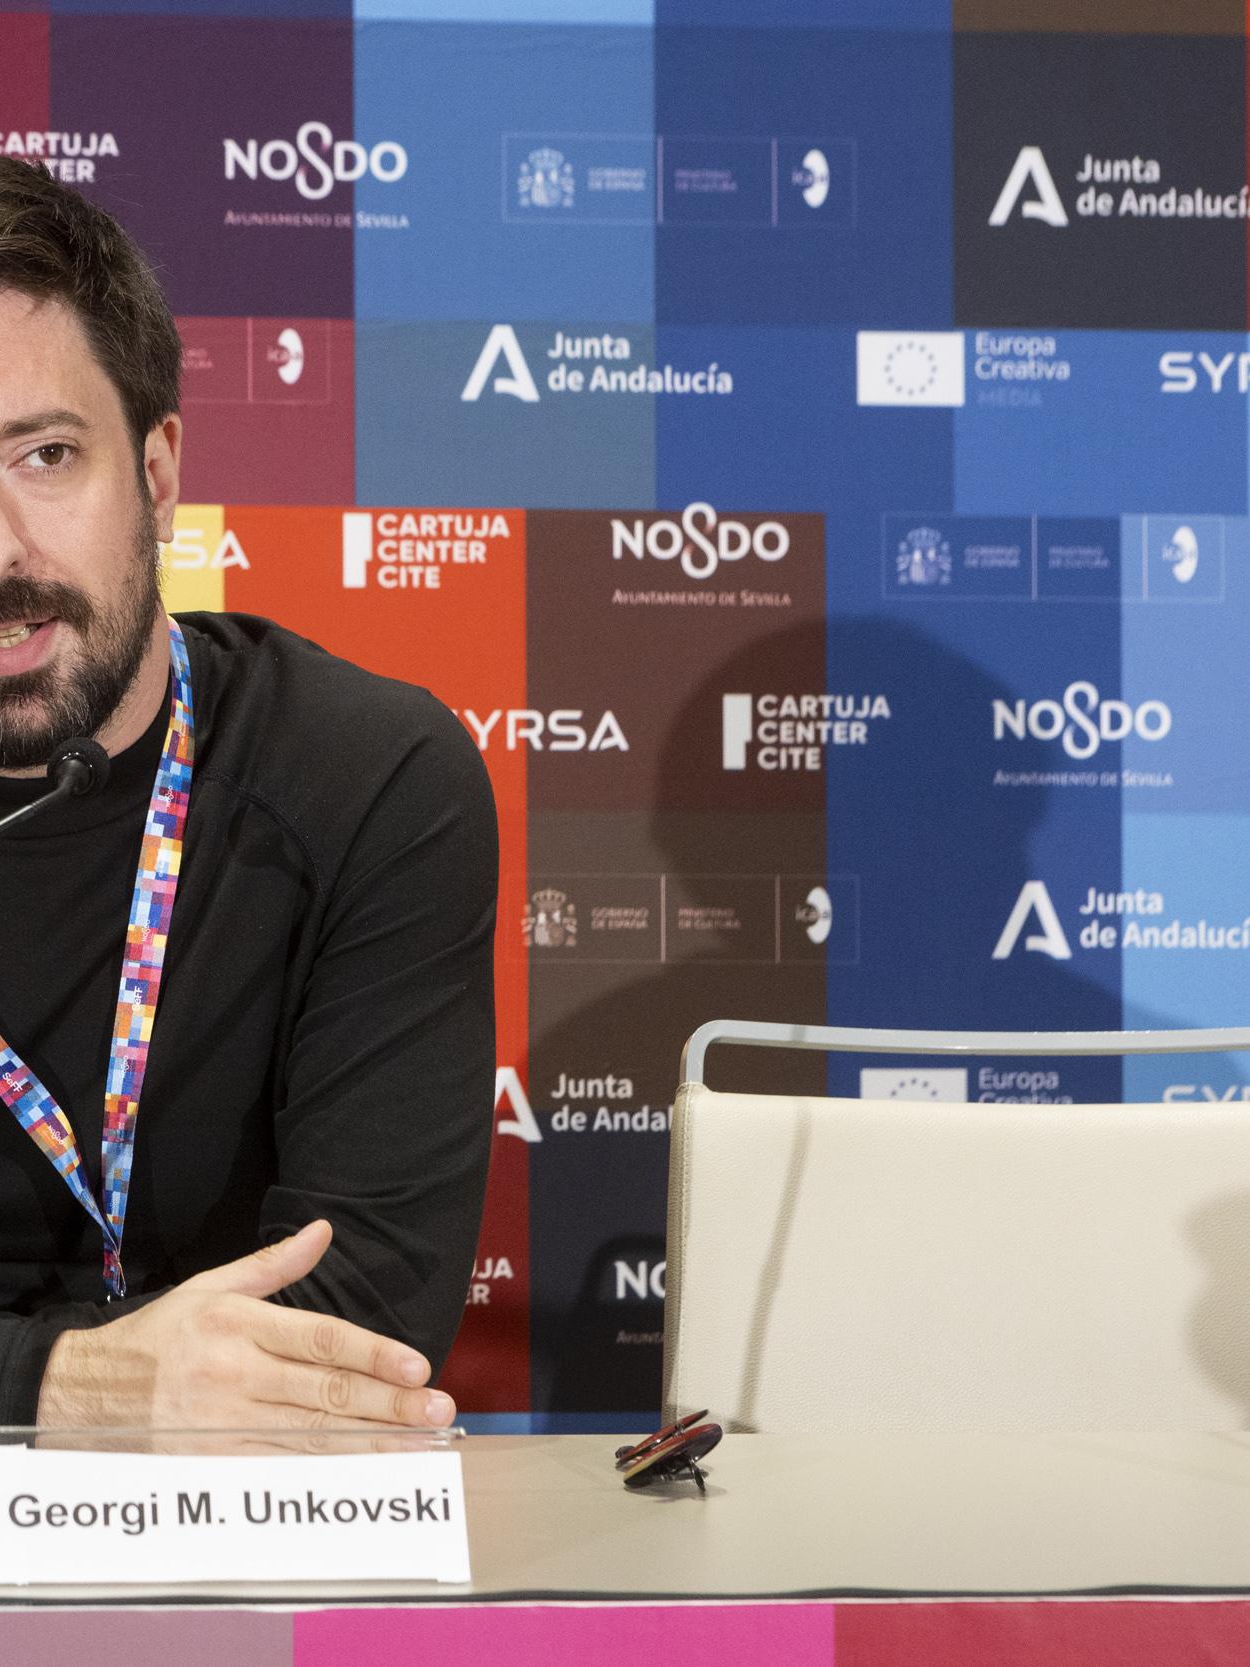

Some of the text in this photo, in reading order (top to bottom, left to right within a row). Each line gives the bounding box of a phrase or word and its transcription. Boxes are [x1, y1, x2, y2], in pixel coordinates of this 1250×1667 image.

[1078, 156, 1161, 183] Junta
[1078, 187, 1250, 218] de Andalucí
[549, 333, 631, 359] Junta
[977, 333, 1057, 360] Europa
[549, 364, 733, 394] de Andalucía
[975, 353, 1071, 380] Creativa
[378, 515, 511, 539] CARTUJA
[378, 540, 486, 564] CENTER
[378, 566, 440, 590] CITE
[758, 696, 891, 719] CARTUJA
[758, 722, 867, 745] CENTER
[759, 748, 821, 771] CITE
[1080, 889, 1163, 915] Junta
[1081, 921, 1117, 949] de
[552, 1075, 633, 1099] Junta
[980, 1068, 1060, 1094] Europa
[552, 1106, 587, 1132] de
[8, 1488, 450, 1536] Georgi M. Unkovski
